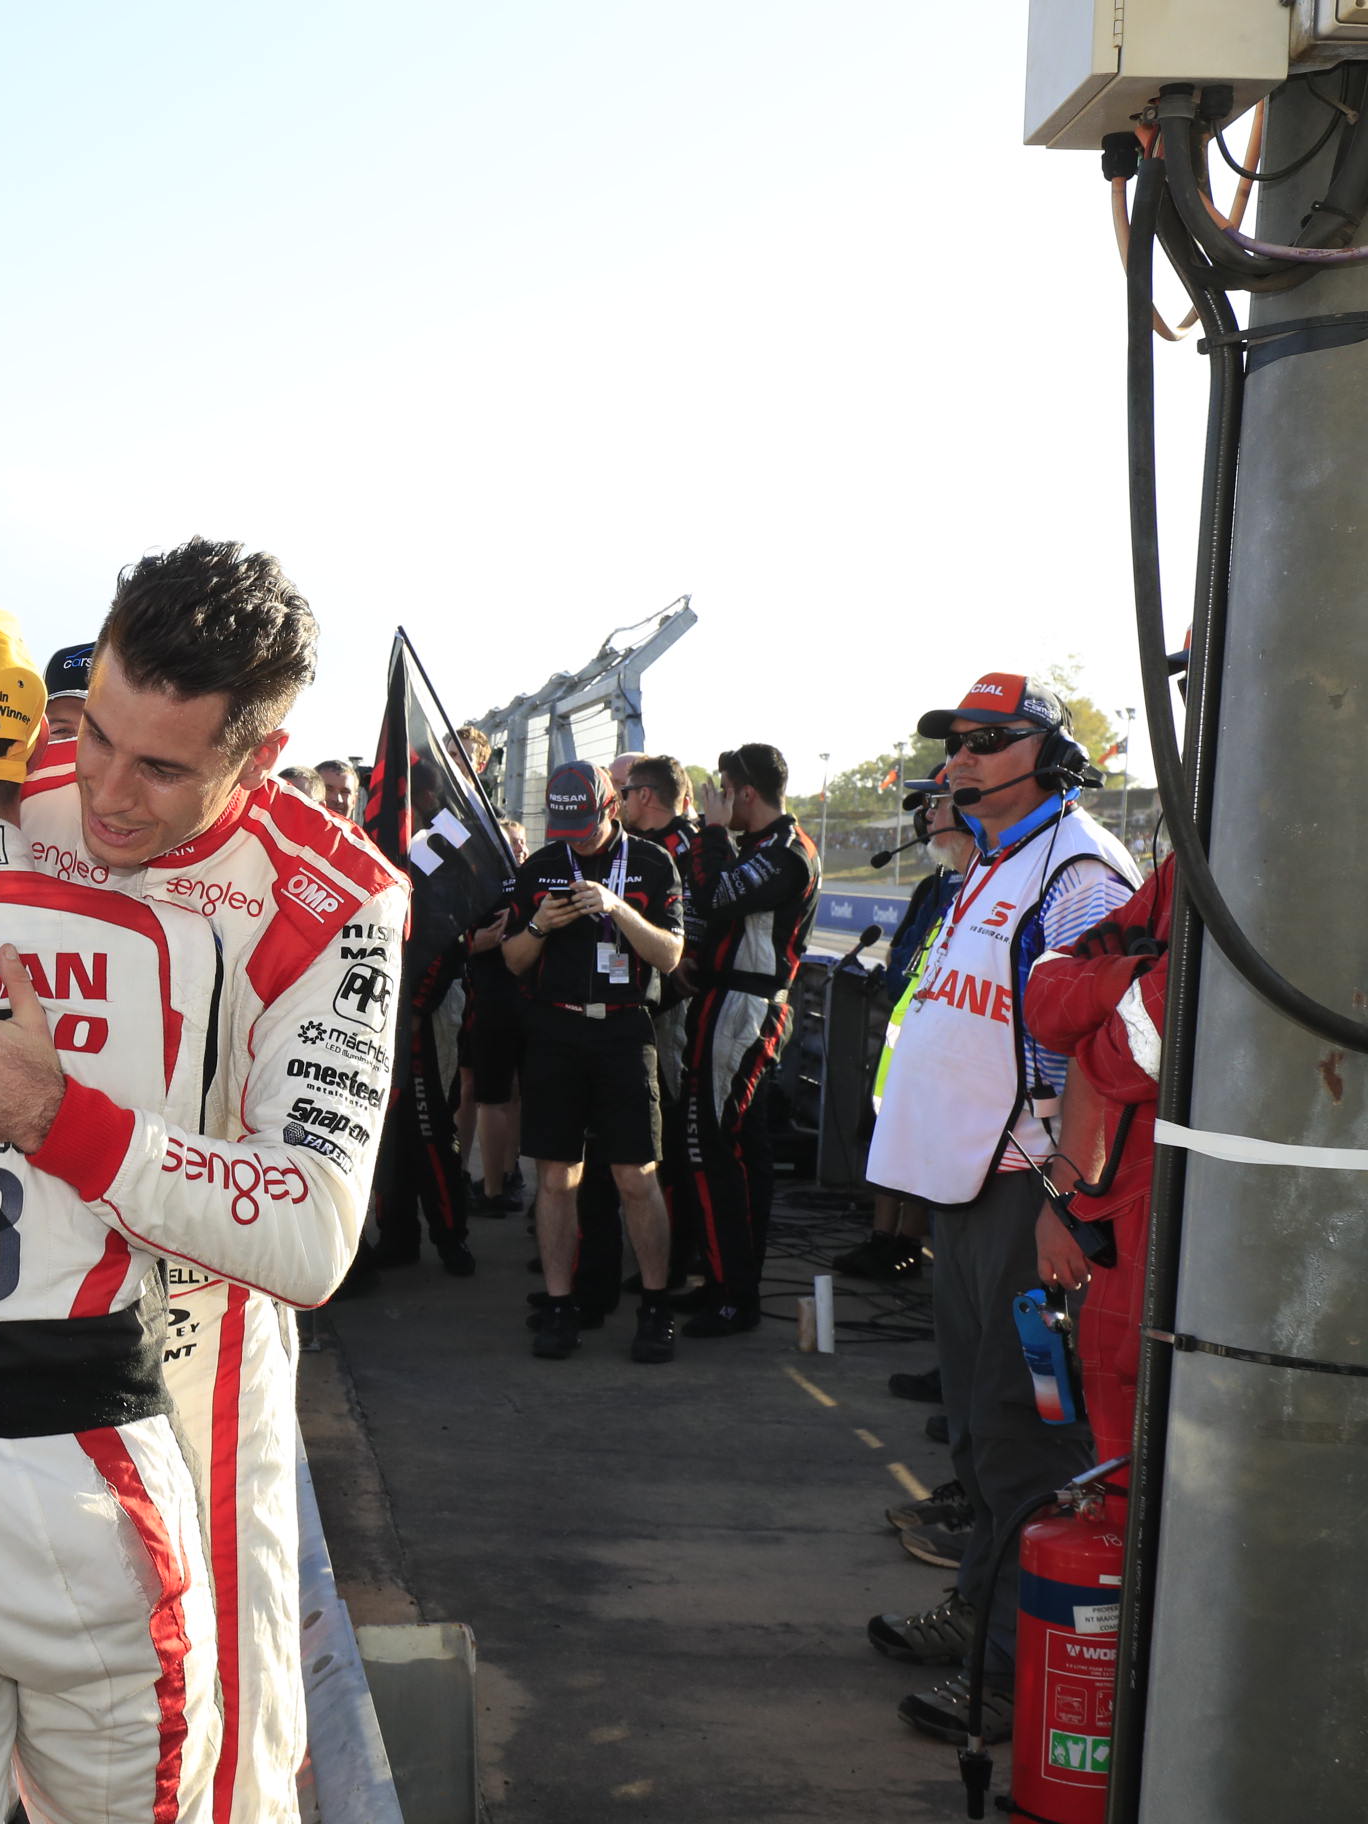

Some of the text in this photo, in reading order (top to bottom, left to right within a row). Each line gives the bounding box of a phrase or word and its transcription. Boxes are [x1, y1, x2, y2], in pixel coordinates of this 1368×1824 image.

[971, 684, 1004, 696] CIAL
[549, 793, 587, 802] NISSAN
[287, 874, 340, 914] OMP
[926, 967, 1012, 1025] LANE
[287, 1058, 385, 1111] onesteel
[161, 1137, 309, 1225] sengled
[169, 1268, 209, 1284] ELL
